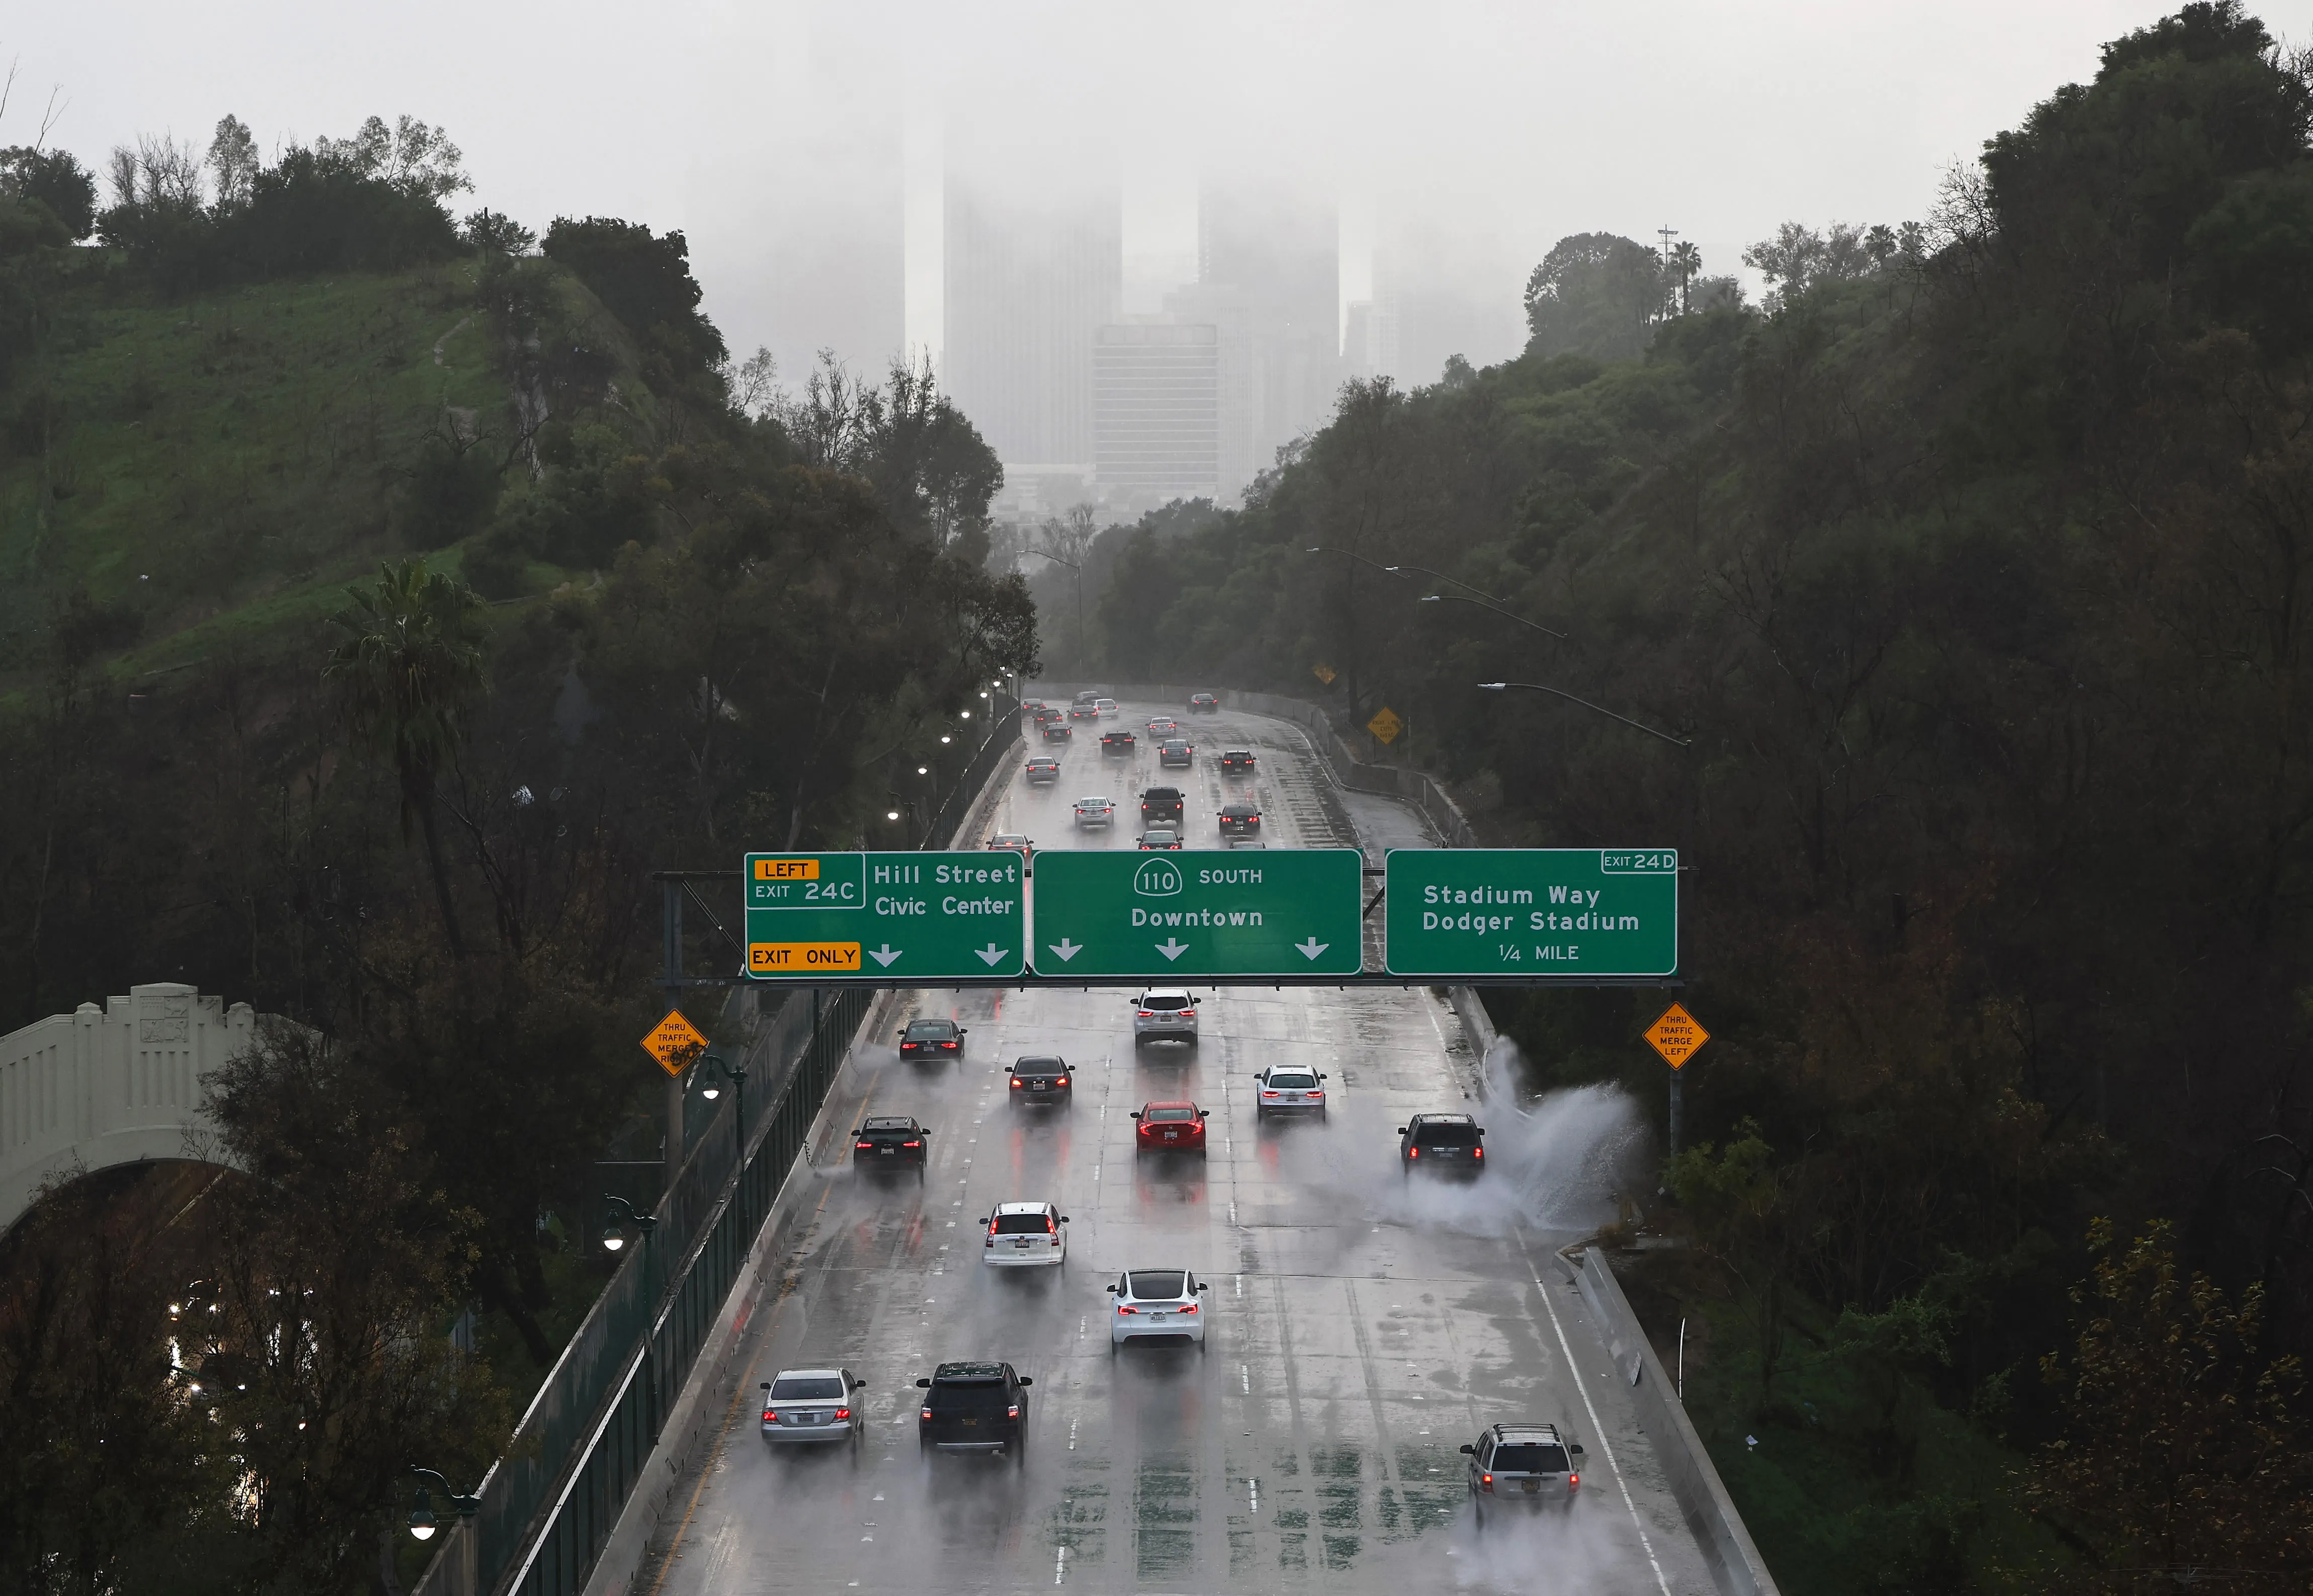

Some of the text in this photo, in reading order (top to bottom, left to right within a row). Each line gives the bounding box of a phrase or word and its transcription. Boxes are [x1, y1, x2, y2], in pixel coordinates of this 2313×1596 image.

[765, 863, 808, 877] LEFT
[1604, 855, 1674, 868] EXIT 24D
[875, 864, 1016, 884] Hill Street
[1143, 869, 1262, 890] 110 SOUTH
[756, 882, 854, 900] EXIT 24C
[1423, 885, 1601, 908] Stadium Way
[875, 896, 1014, 915] Civic Center
[1132, 908, 1263, 926] Downtown
[1423, 912, 1639, 936] Dodger Stadium
[753, 949, 857, 964] EXIT ONLY
[1535, 946, 1579, 960] MILE
